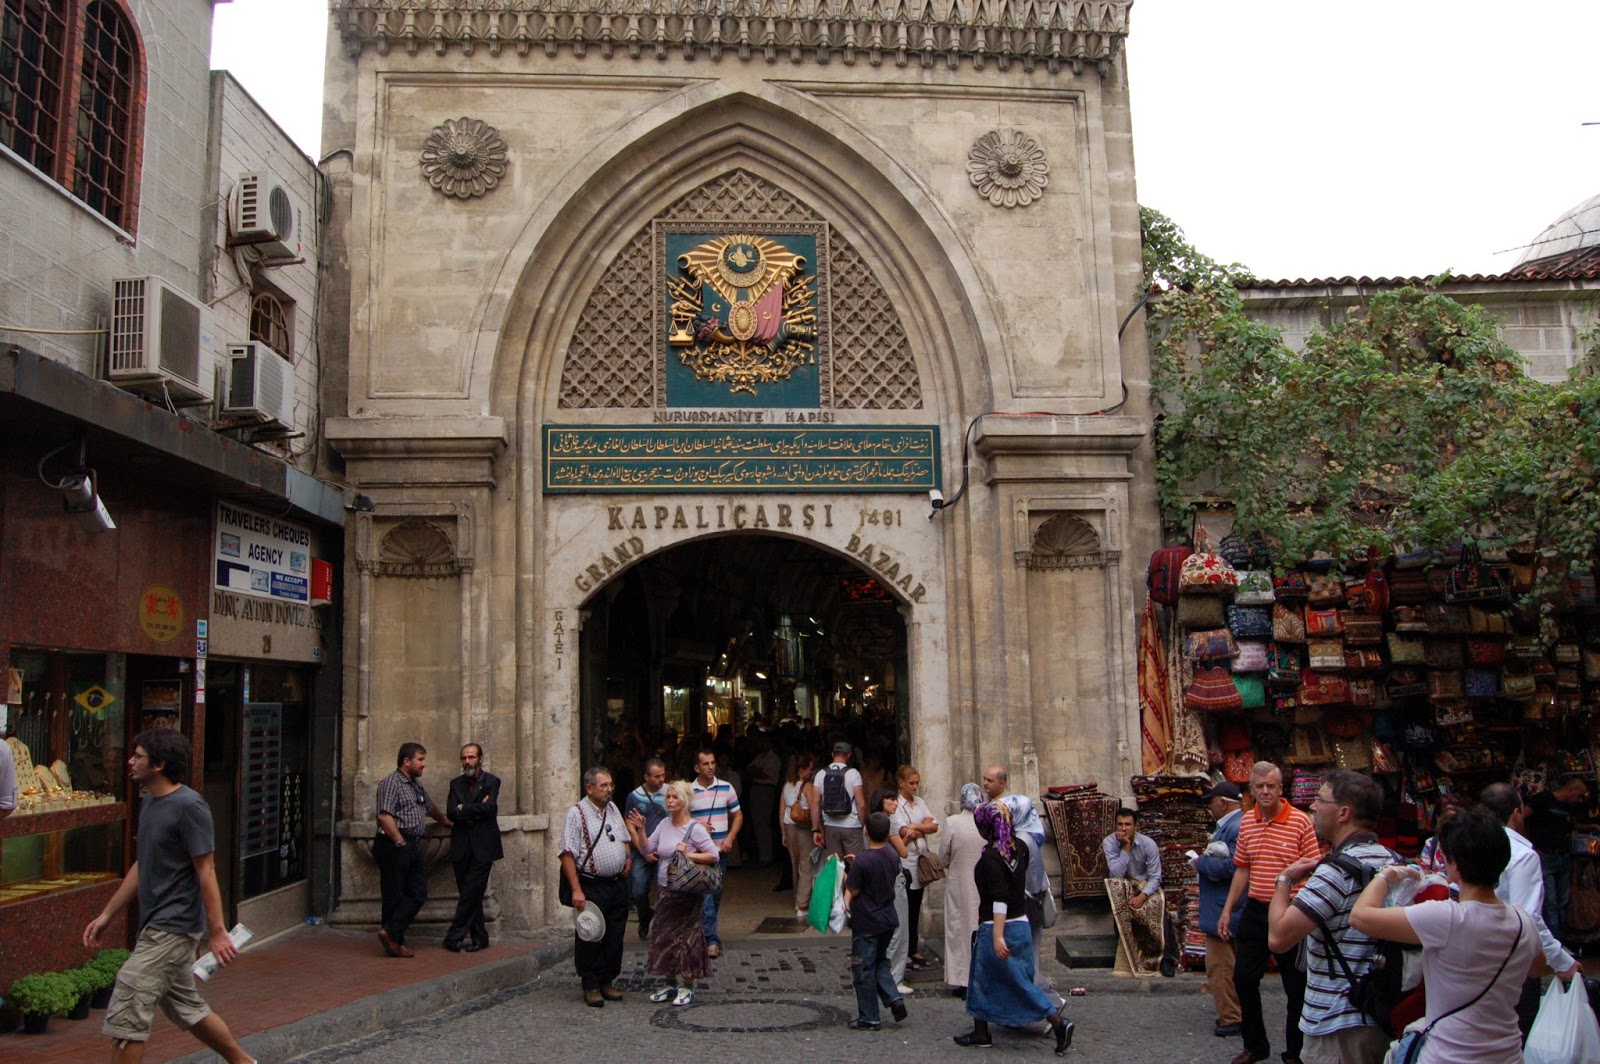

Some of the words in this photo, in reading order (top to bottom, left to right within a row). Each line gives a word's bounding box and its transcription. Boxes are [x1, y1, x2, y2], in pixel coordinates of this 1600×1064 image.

[220, 505, 270, 536] TRAVELERS
[273, 522, 309, 546] CHEQUES
[608, 504, 834, 530] KAPALIÇARŞI
[859, 509, 902, 526] 1461
[248, 542, 283, 566] AGENCY
[574, 535, 644, 593] GRAND
[845, 534, 928, 604] BAZAAR
[554, 610, 564, 654] GATE
